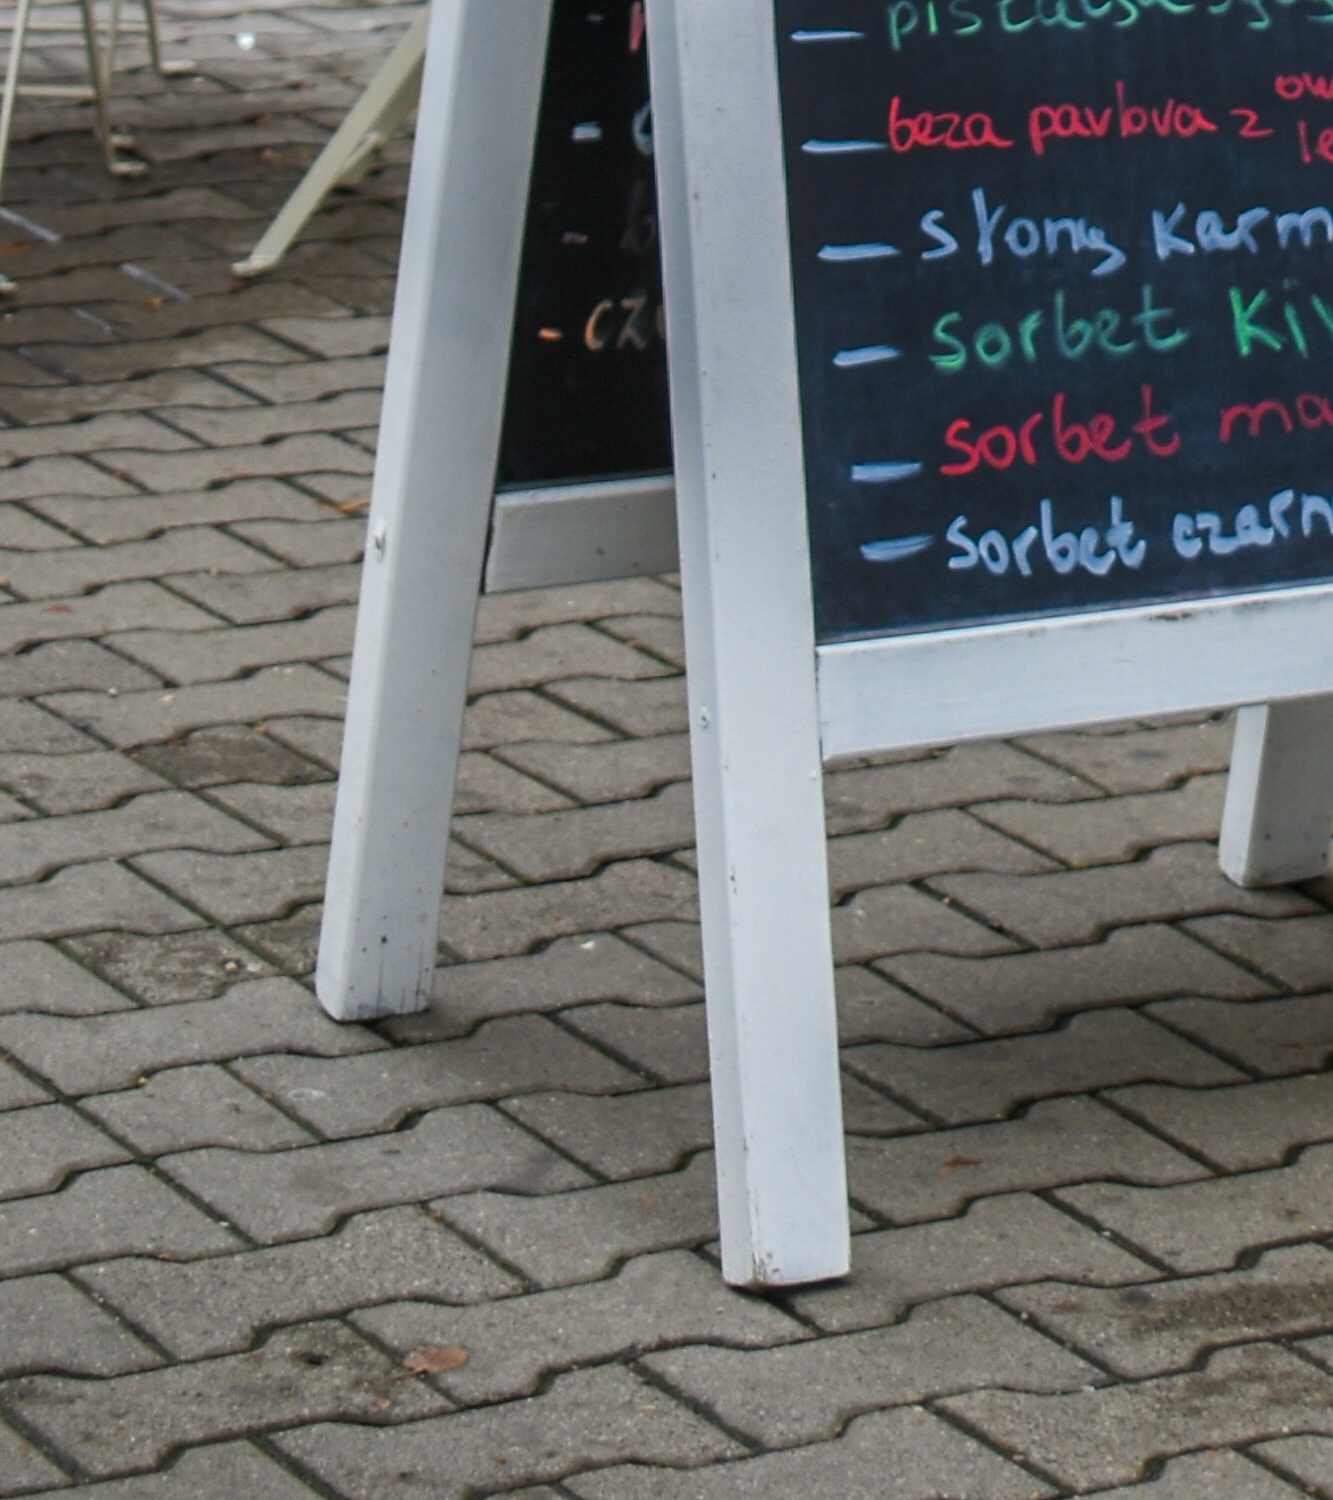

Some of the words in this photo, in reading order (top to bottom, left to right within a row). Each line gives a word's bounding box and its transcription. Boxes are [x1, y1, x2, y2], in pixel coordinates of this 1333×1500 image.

[888, 96, 1012, 150] beza
[1028, 81, 1217, 155] pavlova
[1231, 109, 1273, 137] z
[920, 187, 1127, 277] słony
[929, 284, 1190, 372] sorbet
[939, 385, 1181, 476] sorbet
[945, 495, 1146, 577] sorbet
